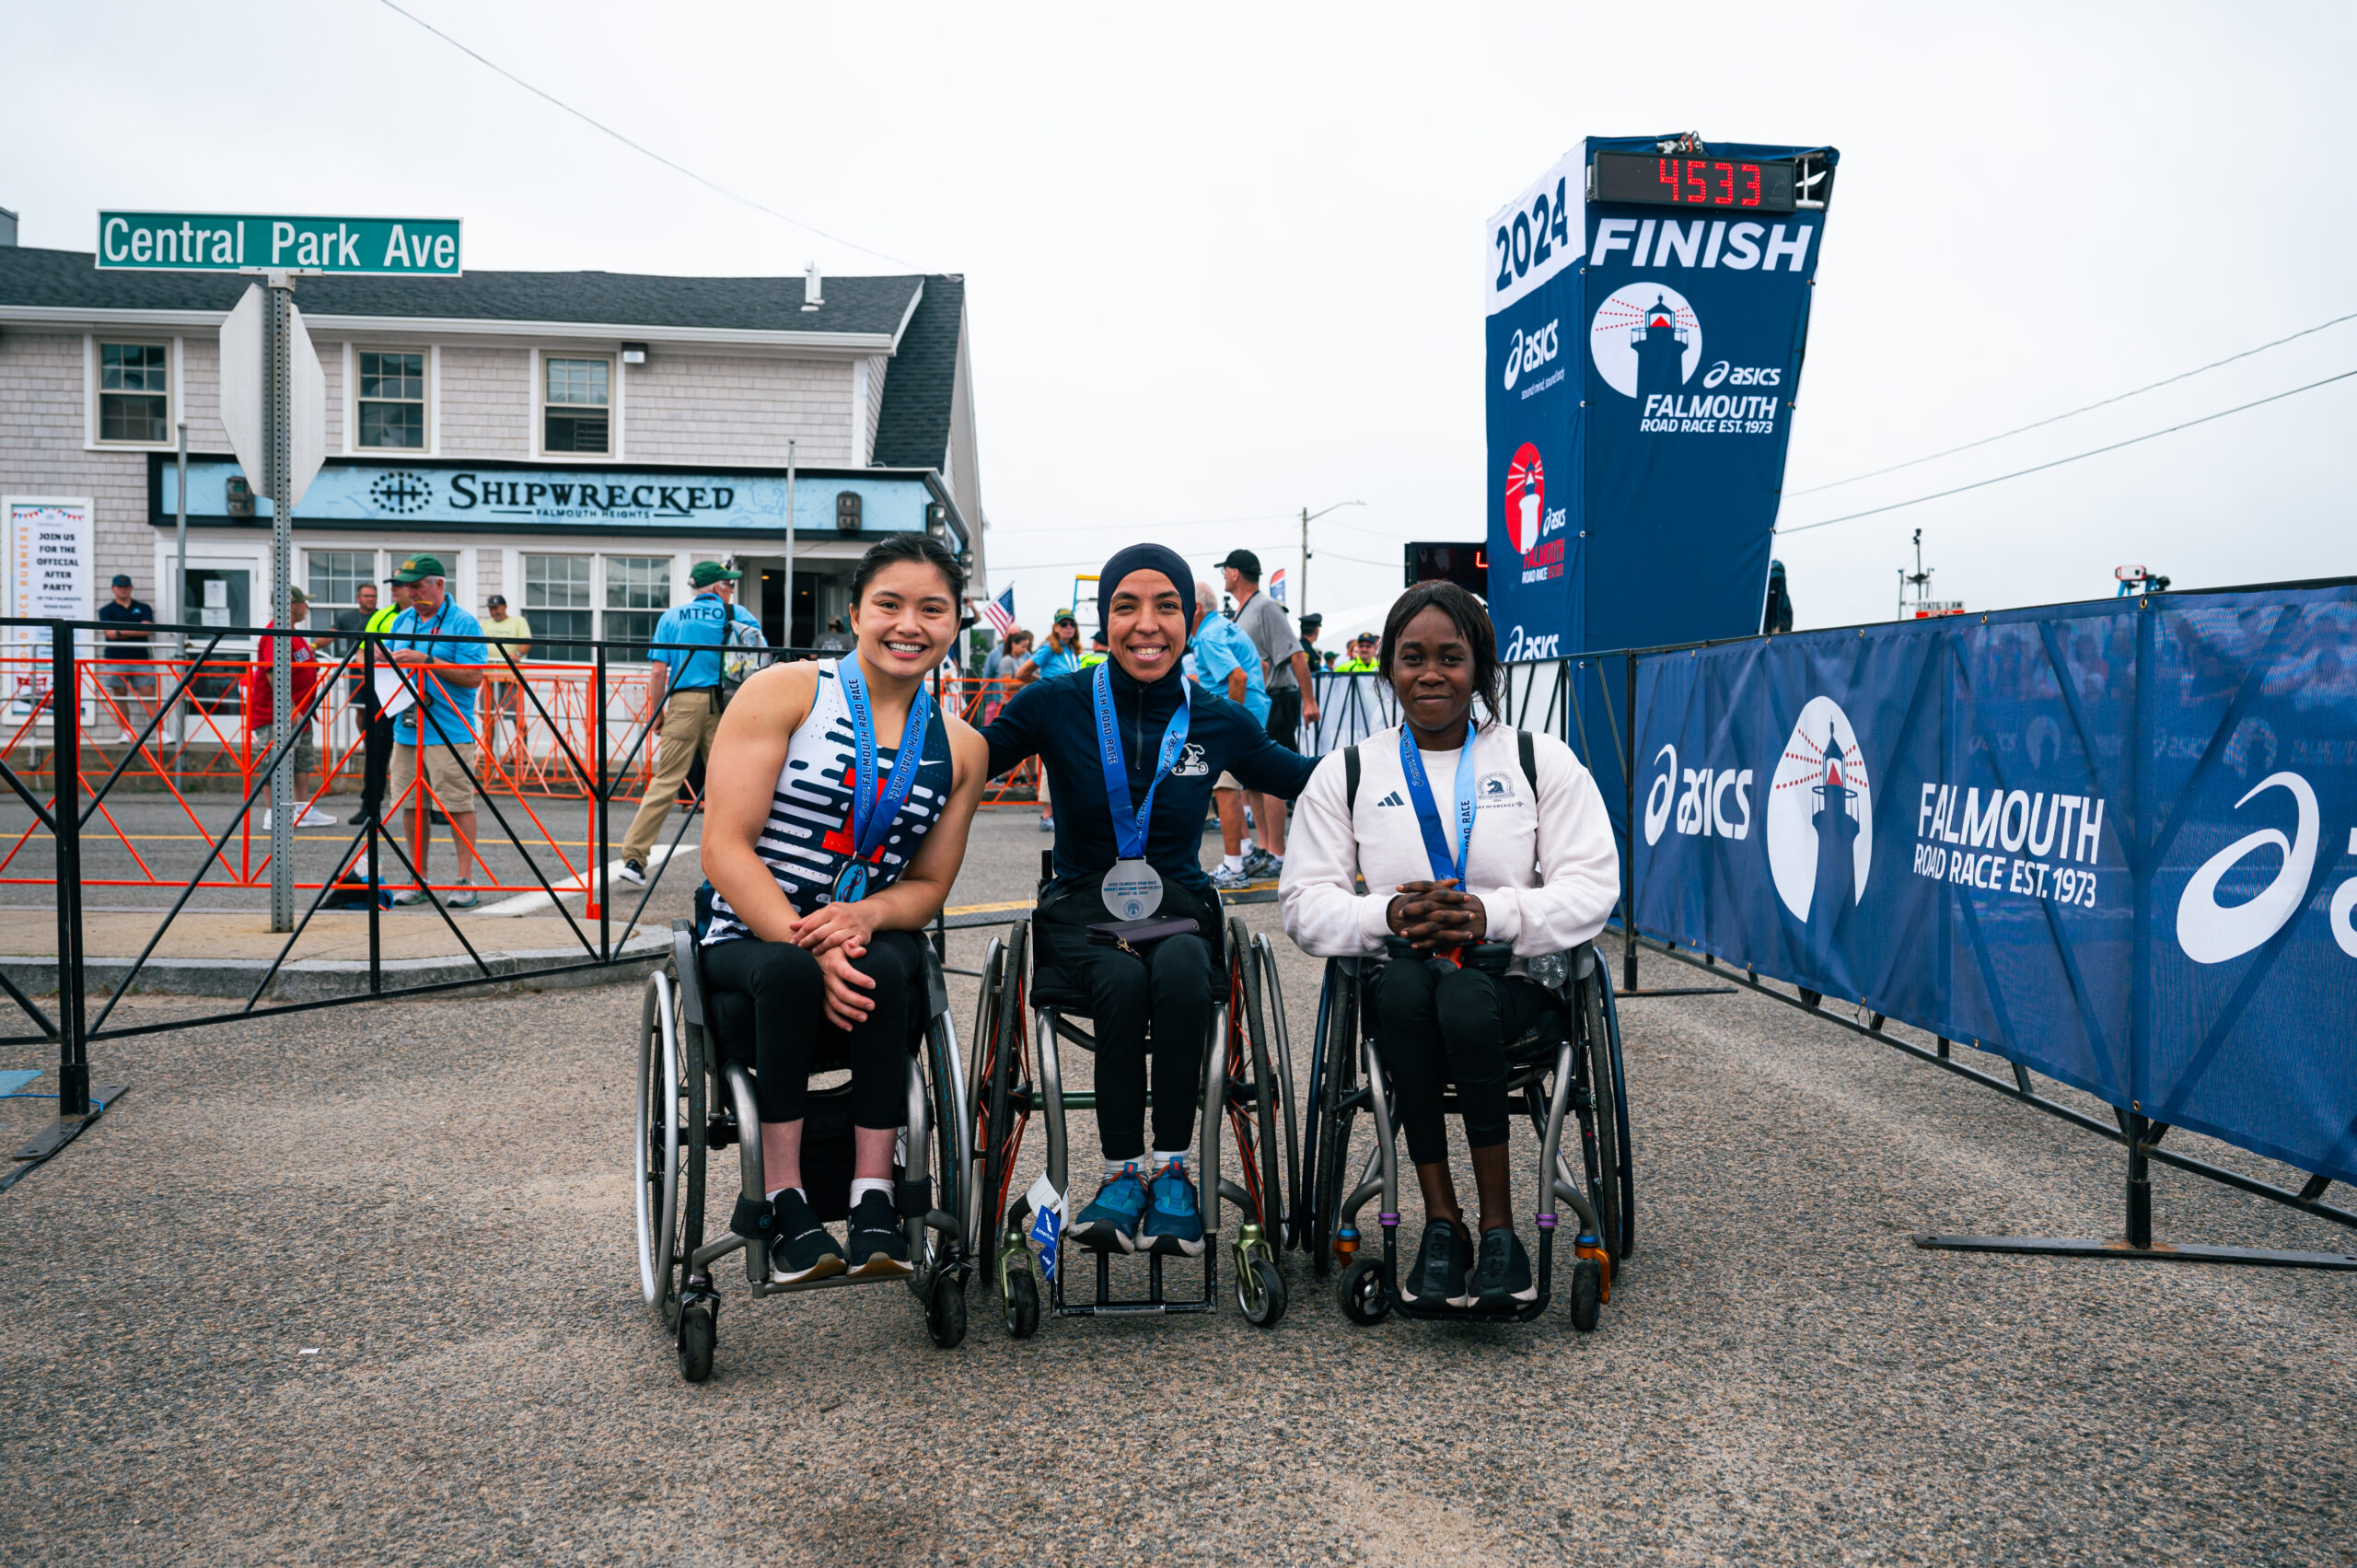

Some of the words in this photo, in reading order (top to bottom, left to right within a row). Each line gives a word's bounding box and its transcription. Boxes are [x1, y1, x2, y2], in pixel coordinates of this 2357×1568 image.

[1658, 158, 1760, 206] 4533
[104, 217, 244, 263] Central
[273, 222, 360, 266] Park
[384, 225, 456, 269] Ave
[1495, 176, 1568, 293] 2024
[1590, 217, 1814, 272] FINISH
[1643, 394, 1778, 420] FALMOUTH
[1640, 419, 1678, 433] ROAD
[1681, 419, 1717, 433] RACE
[449, 473, 735, 514] SHIPWRECKED
[537, 508, 597, 517] FALMOUTH
[601, 510, 650, 519] HEIGHTS
[37, 558, 79, 566] OFFICIAL
[1523, 538, 1565, 570] FALMOUTH
[1522, 569, 1536, 584] ROAD
[1536, 566, 1548, 582] RACE
[679, 608, 724, 621] MTFO
[1945, 600, 1963, 610] LAW
[848, 679, 863, 702] RACE
[854, 703, 868, 729] ROAD
[907, 704, 923, 748] FALMOUTH
[1100, 708, 1113, 737] ROAD
[860, 730, 872, 785] FALMOUTH
[899, 747, 915, 775] ROAD
[1104, 738, 1118, 766] RACE
[887, 774, 906, 802] RACE
[1460, 800, 1471, 823] RACE
[1918, 783, 2105, 865] FALMOUTH
[1913, 843, 1946, 880] ROAD
[1948, 850, 2007, 890] RACE
[2009, 859, 2049, 899] EST.
[2052, 867, 2097, 909] 1973
[1035, 1226, 1055, 1242] American
